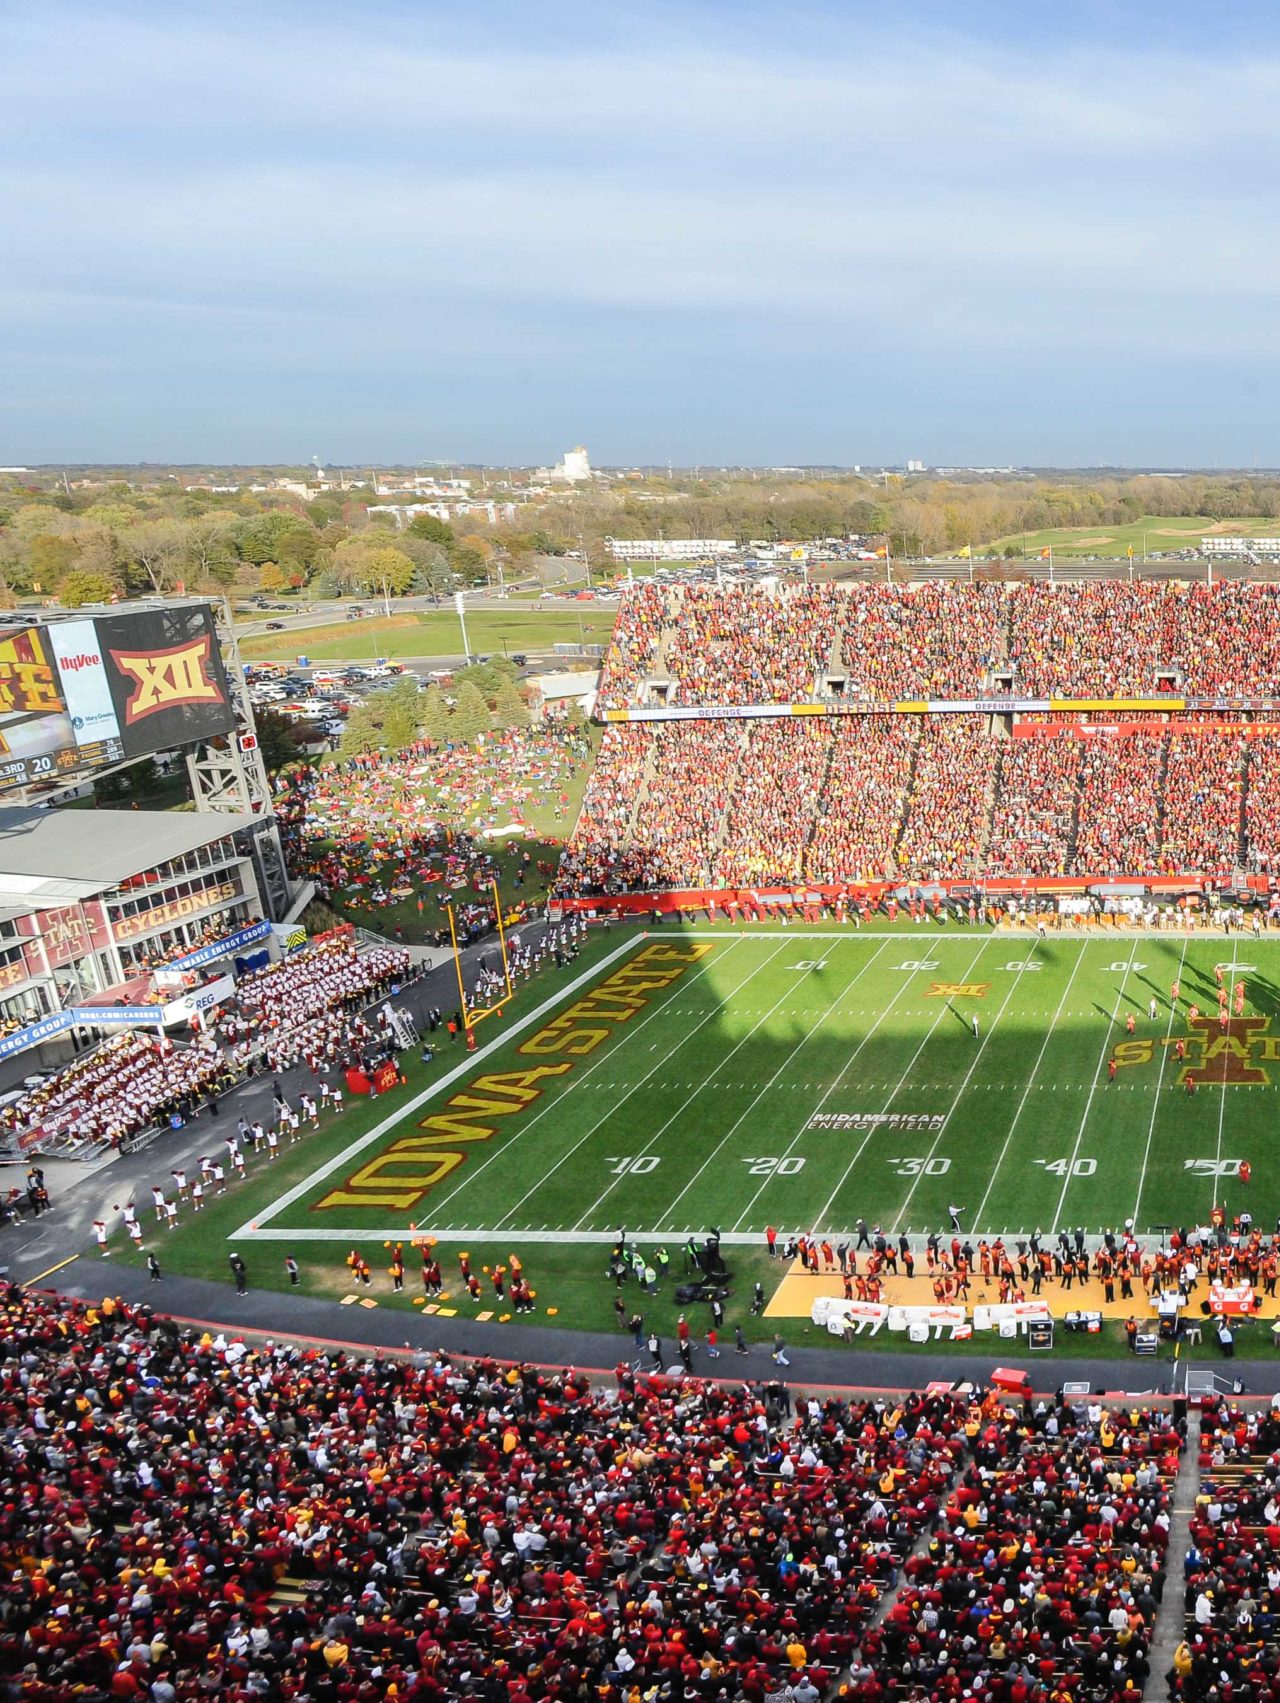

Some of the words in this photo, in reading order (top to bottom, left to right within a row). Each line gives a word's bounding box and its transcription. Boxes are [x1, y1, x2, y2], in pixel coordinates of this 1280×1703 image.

[698, 709, 742, 717] DEFENSE
[825, 703, 896, 714] DEFENSE
[32, 757, 51, 772] 20
[116, 883, 236, 938] CYCLONES
[211, 938, 240, 955] ENERGY
[243, 925, 267, 941] GROUP
[195, 993, 215, 1010] REG
[32, 1017, 67, 1038] GROUP
[311, 1062, 572, 1210] IOWA
[517, 943, 716, 1056] STATE
[807, 1121, 881, 1130] ENERGY
[888, 1122, 941, 1130] FIELD
[812, 1113, 946, 1122] MIDAMERICAN
[611, 1156, 661, 1174] 10
[748, 1157, 806, 1175] 20
[897, 1158, 952, 1175] 30
[1044, 1158, 1098, 1176] 40
[1184, 1159, 1243, 1177] 50
